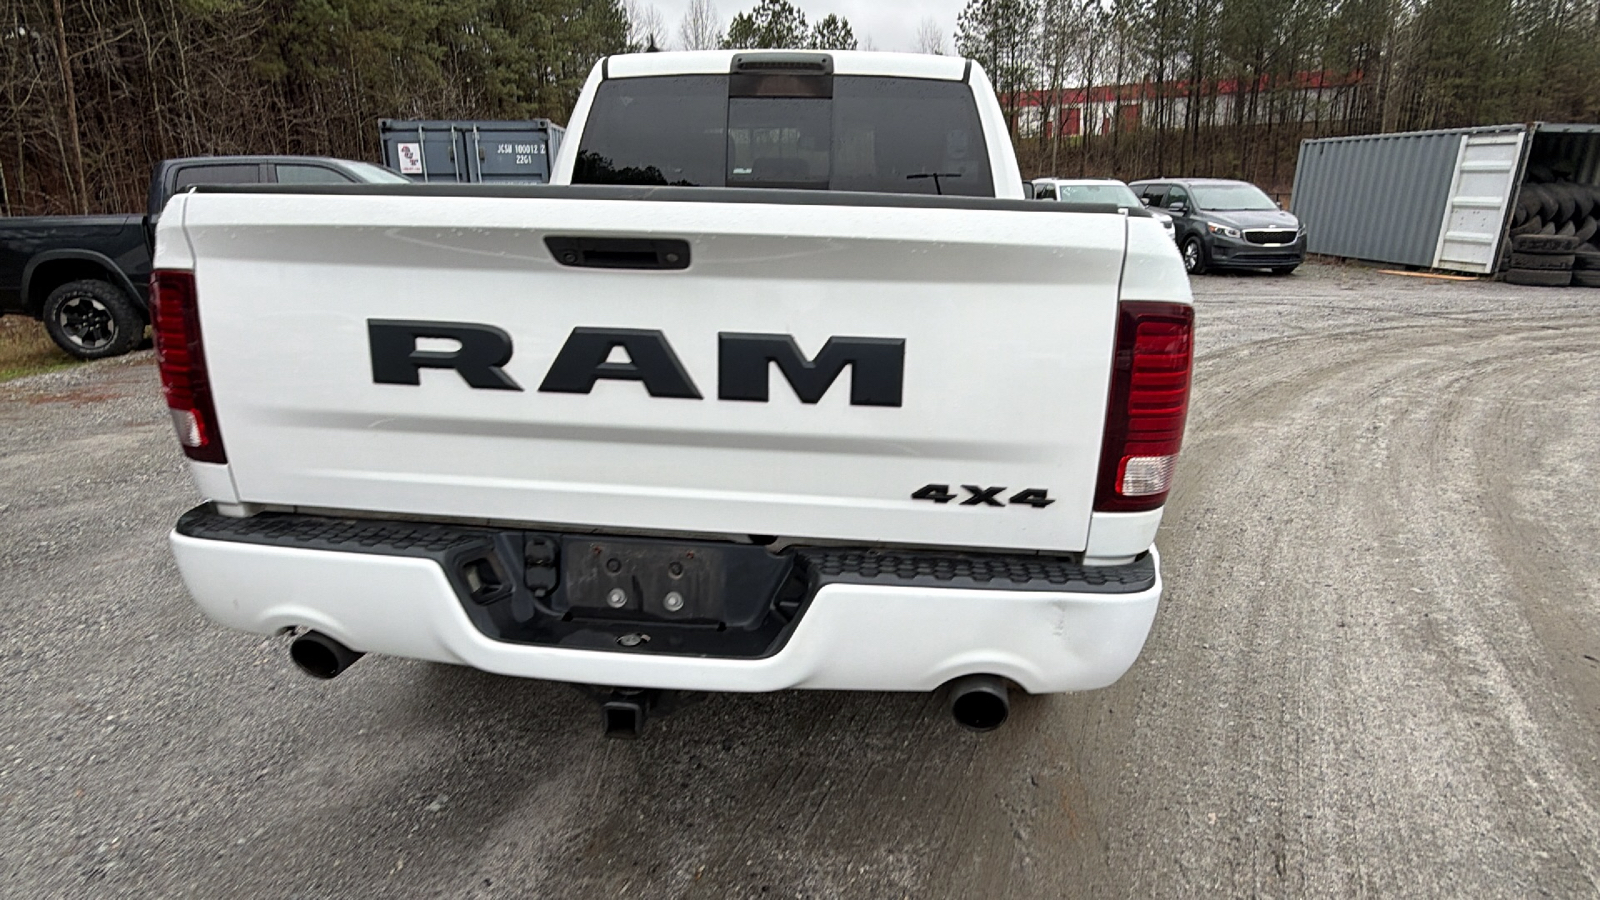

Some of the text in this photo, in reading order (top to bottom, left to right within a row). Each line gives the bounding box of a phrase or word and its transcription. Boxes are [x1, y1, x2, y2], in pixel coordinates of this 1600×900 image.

[515, 144, 538, 154] 100012
[516, 154, 532, 164] 22G1
[367, 318, 906, 407] RAM
[911, 484, 1056, 508] 4X4
